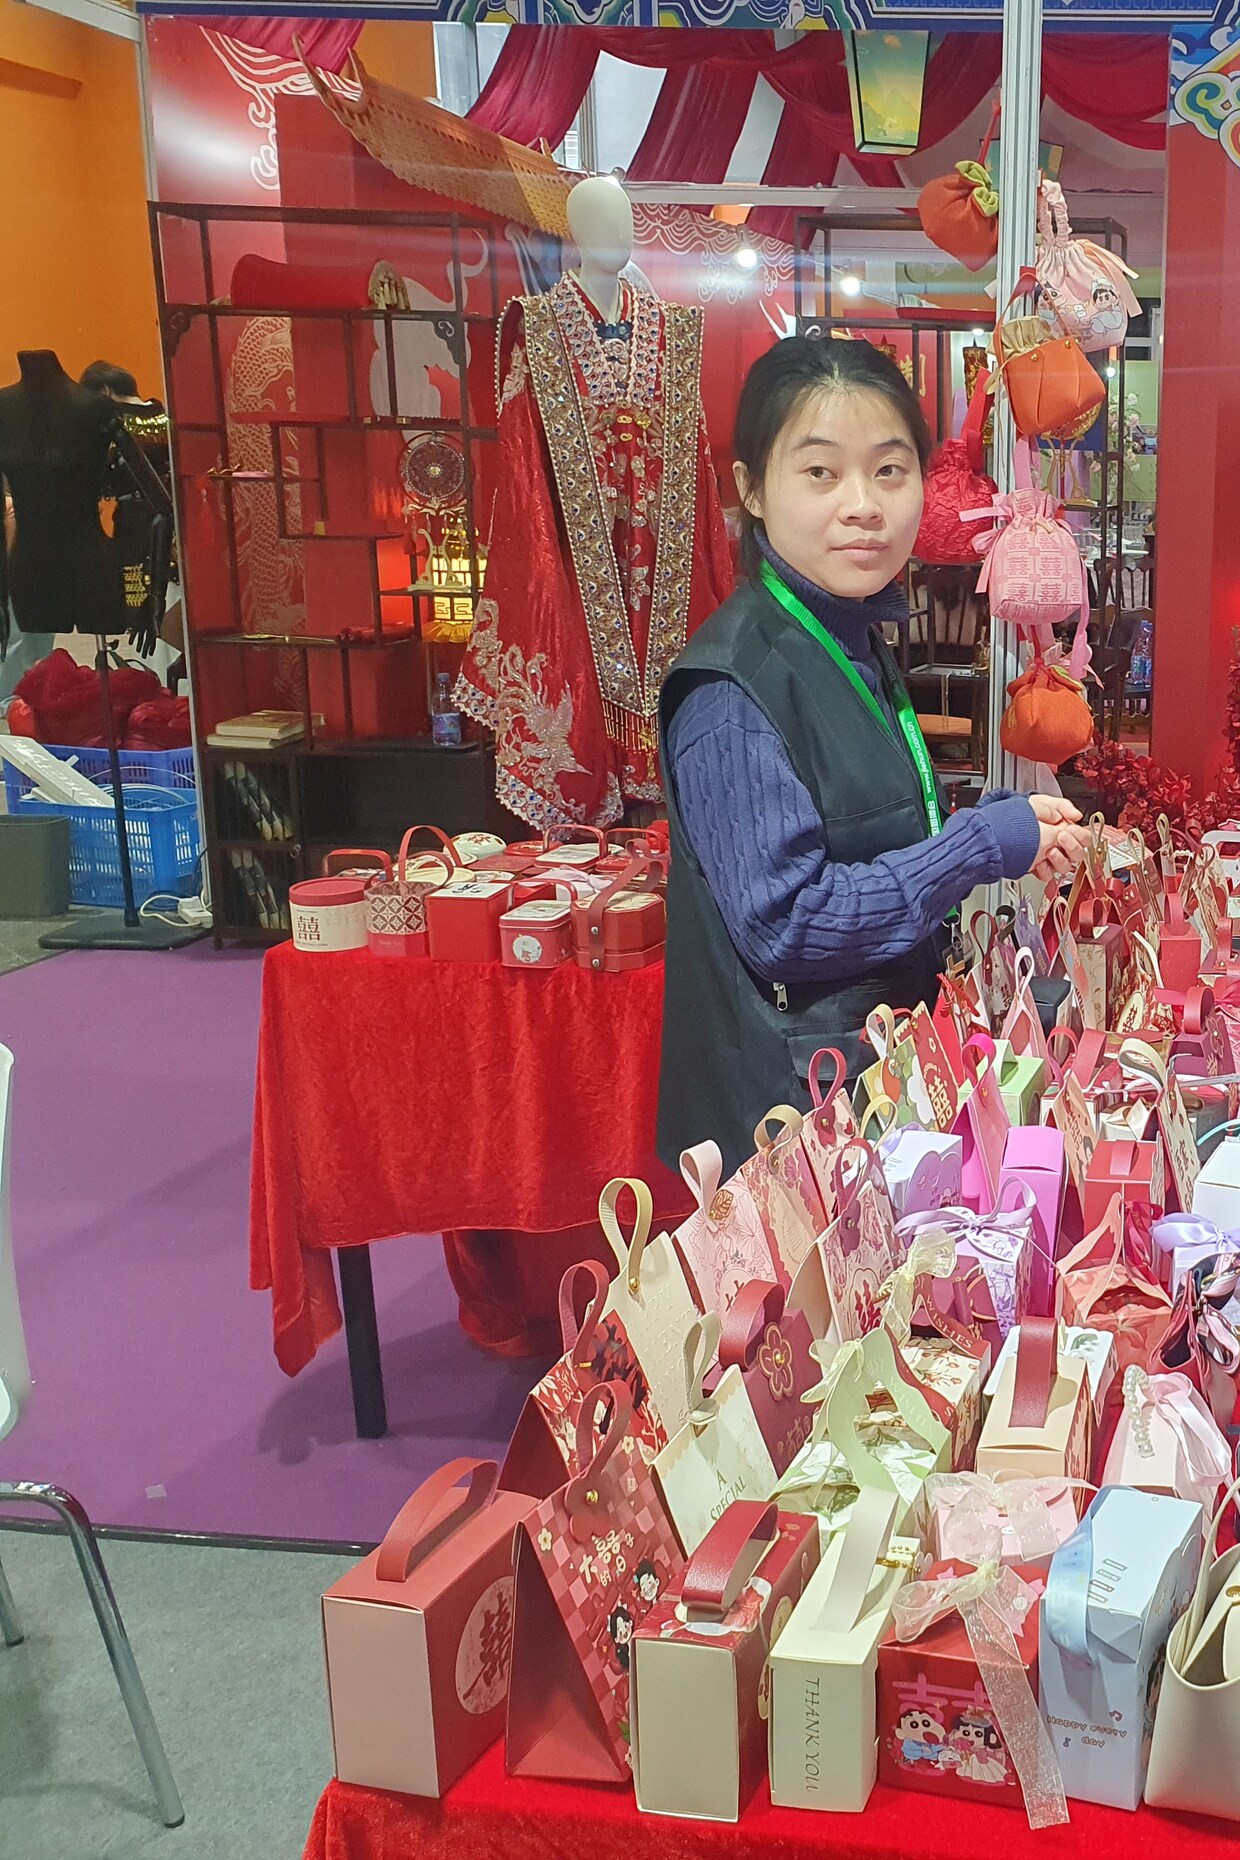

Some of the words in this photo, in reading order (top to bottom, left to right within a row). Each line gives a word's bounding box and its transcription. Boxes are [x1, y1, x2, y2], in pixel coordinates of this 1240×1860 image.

[296, 915, 321, 941] 囍
[928, 1074, 954, 1129] 囍
[925, 1294, 974, 1348] WISHES
[710, 1476, 747, 1521] SPECIAL
[716, 1470, 728, 1491] A
[804, 1677, 820, 1747] THANK
[1046, 1714, 1088, 1732] Happy
[1090, 1725, 1128, 1738] every
[1081, 1736, 1106, 1748] day
[804, 1747, 820, 1793] YOU
